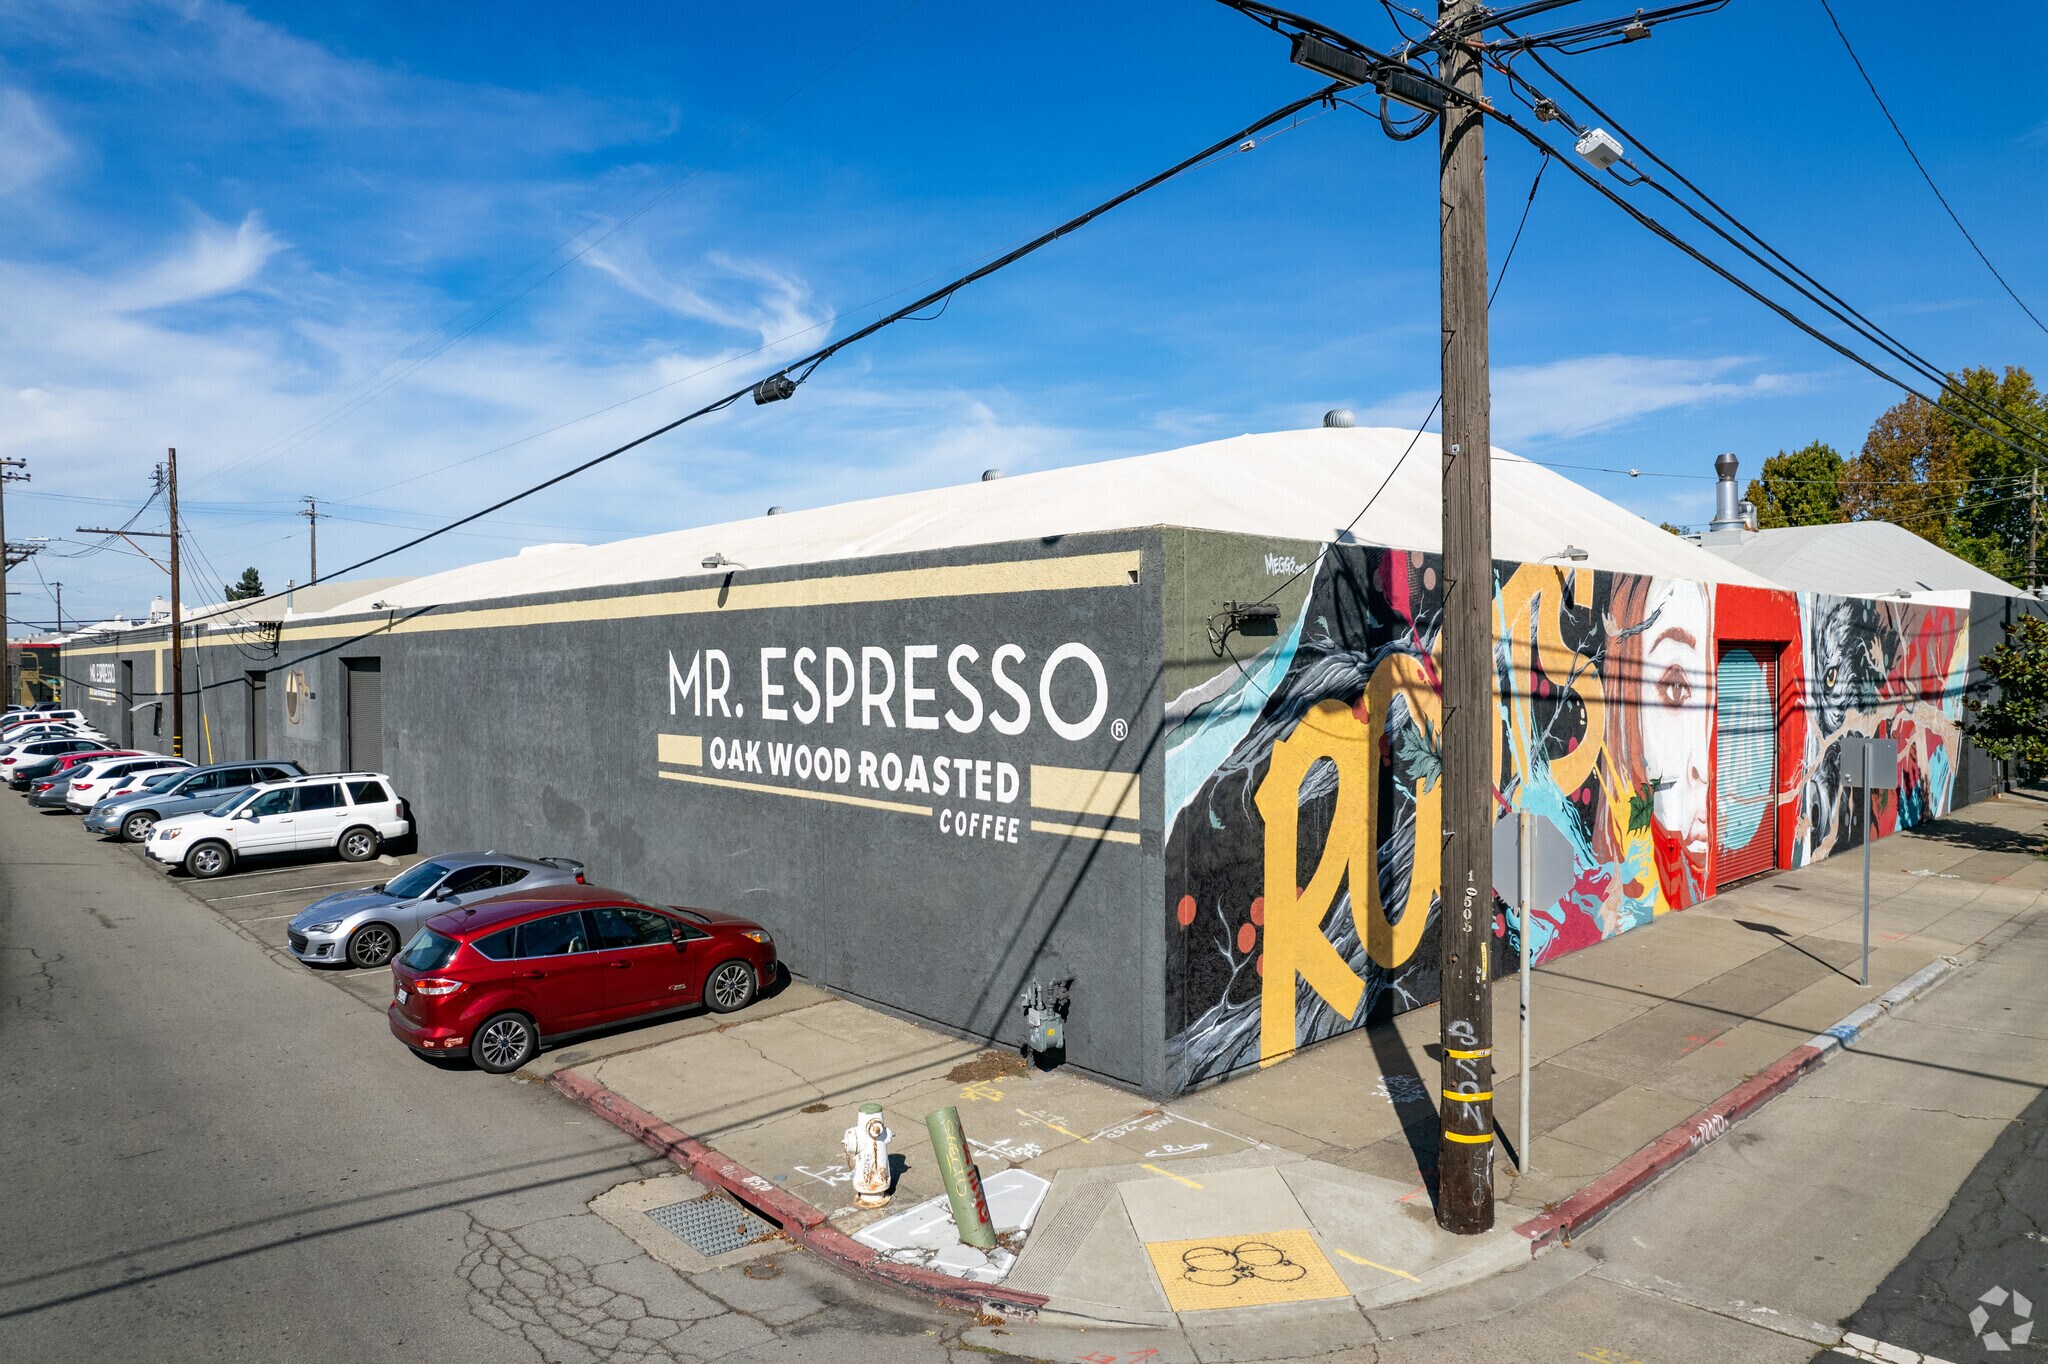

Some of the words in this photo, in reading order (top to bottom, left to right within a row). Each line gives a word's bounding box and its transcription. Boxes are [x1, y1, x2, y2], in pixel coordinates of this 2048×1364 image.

[668, 649, 743, 719] MR.
[760, 642, 1109, 741] ESPRESSO
[709, 736, 763, 774] OAK
[767, 741, 851, 784] WOOD
[858, 749, 1021, 804] ROASTED
[939, 808, 1021, 844] COFFEE
